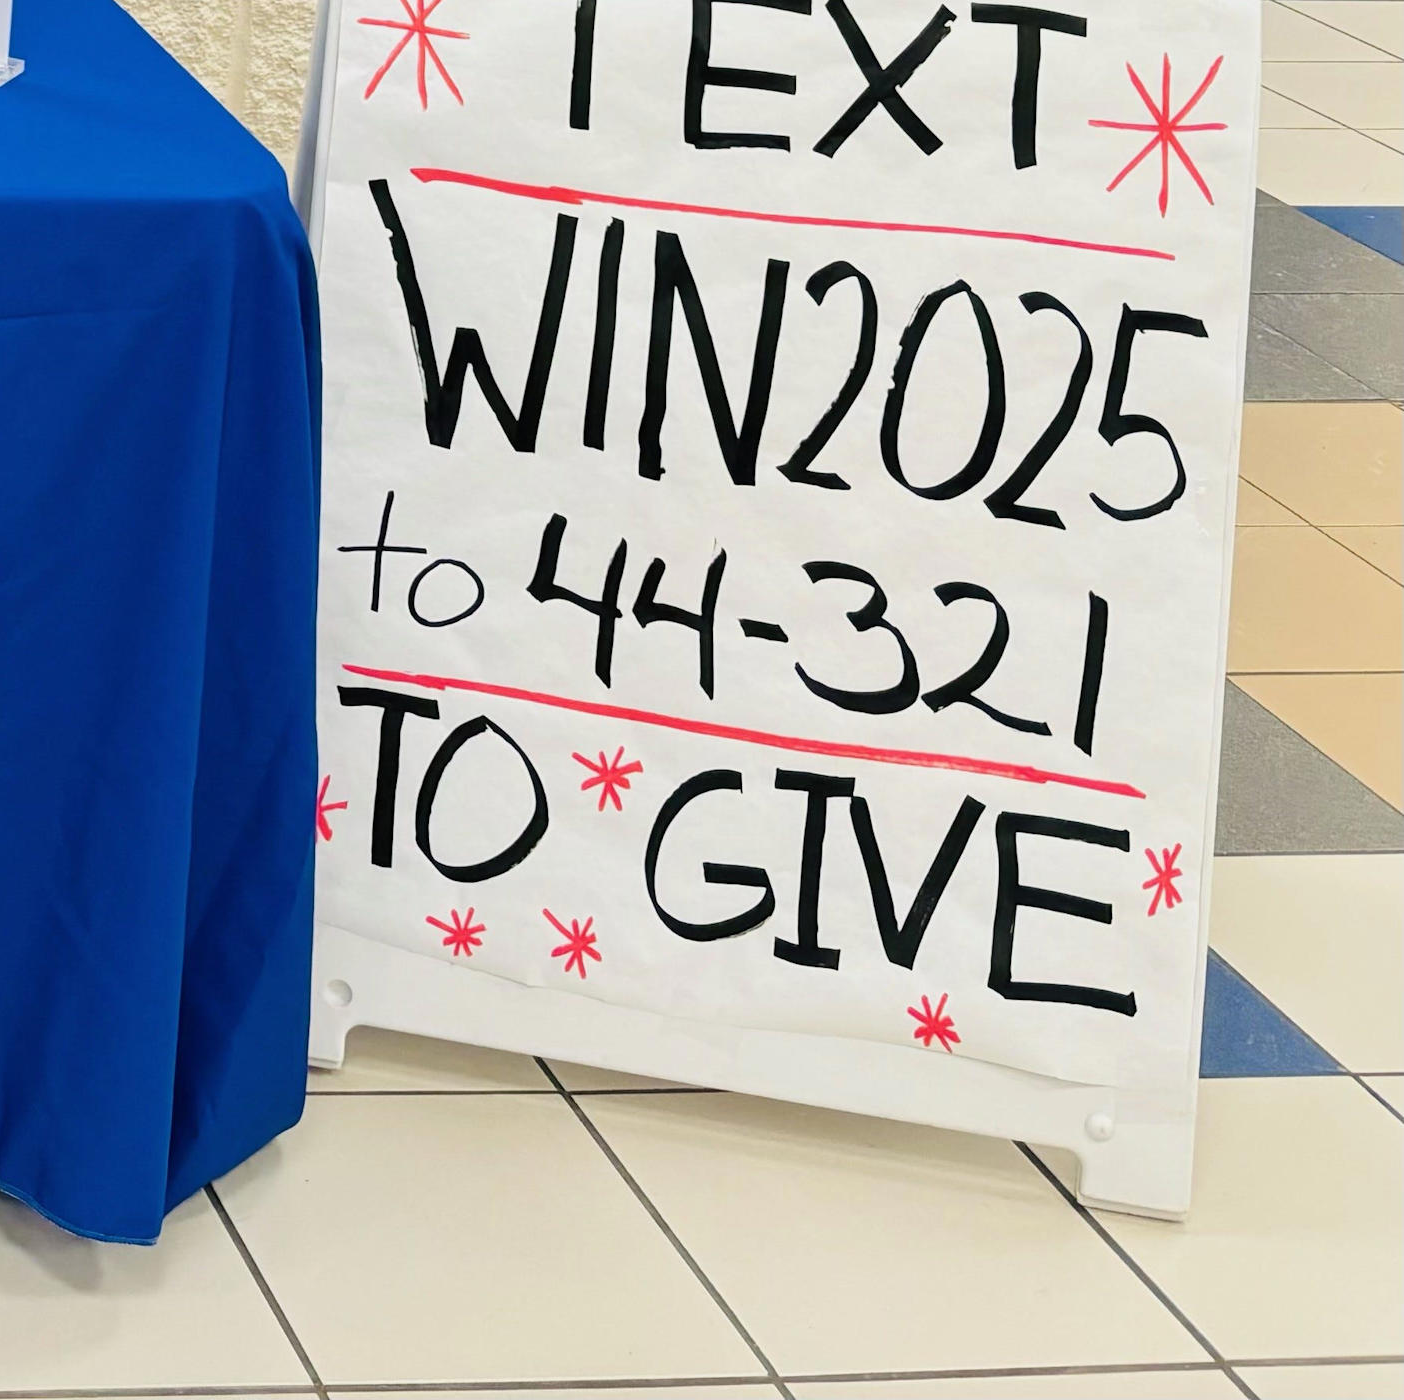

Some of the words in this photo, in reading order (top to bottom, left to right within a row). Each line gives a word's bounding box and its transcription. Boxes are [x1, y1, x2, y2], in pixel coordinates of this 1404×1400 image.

[369, 179, 1208, 530] WIN2025
[338, 490, 485, 628] to
[527, 514, 1108, 758] 44-321
[338, 685, 550, 884] TO
[644, 767, 1135, 1017] GIVE
